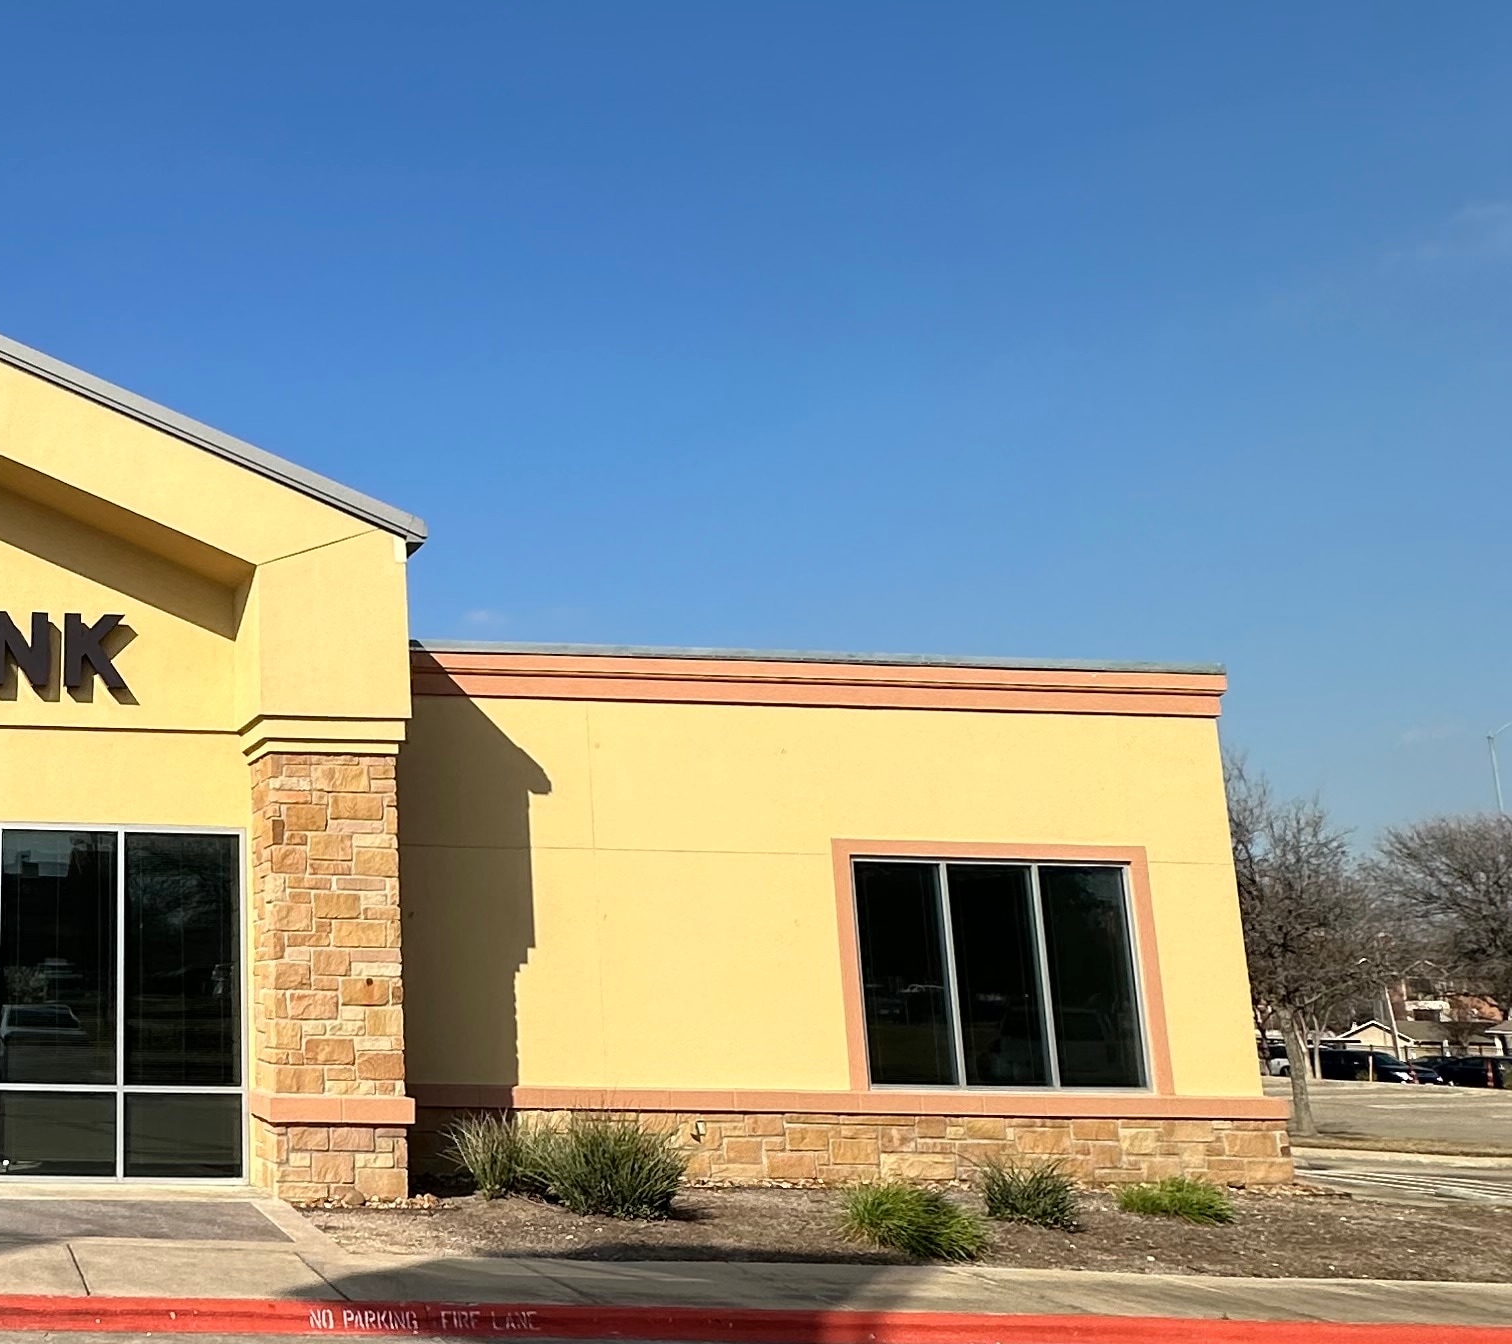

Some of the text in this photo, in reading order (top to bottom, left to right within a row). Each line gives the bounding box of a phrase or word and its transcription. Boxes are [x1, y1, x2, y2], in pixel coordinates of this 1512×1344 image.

[309, 1308, 541, 1331] NO PARKING FIRE LANE
